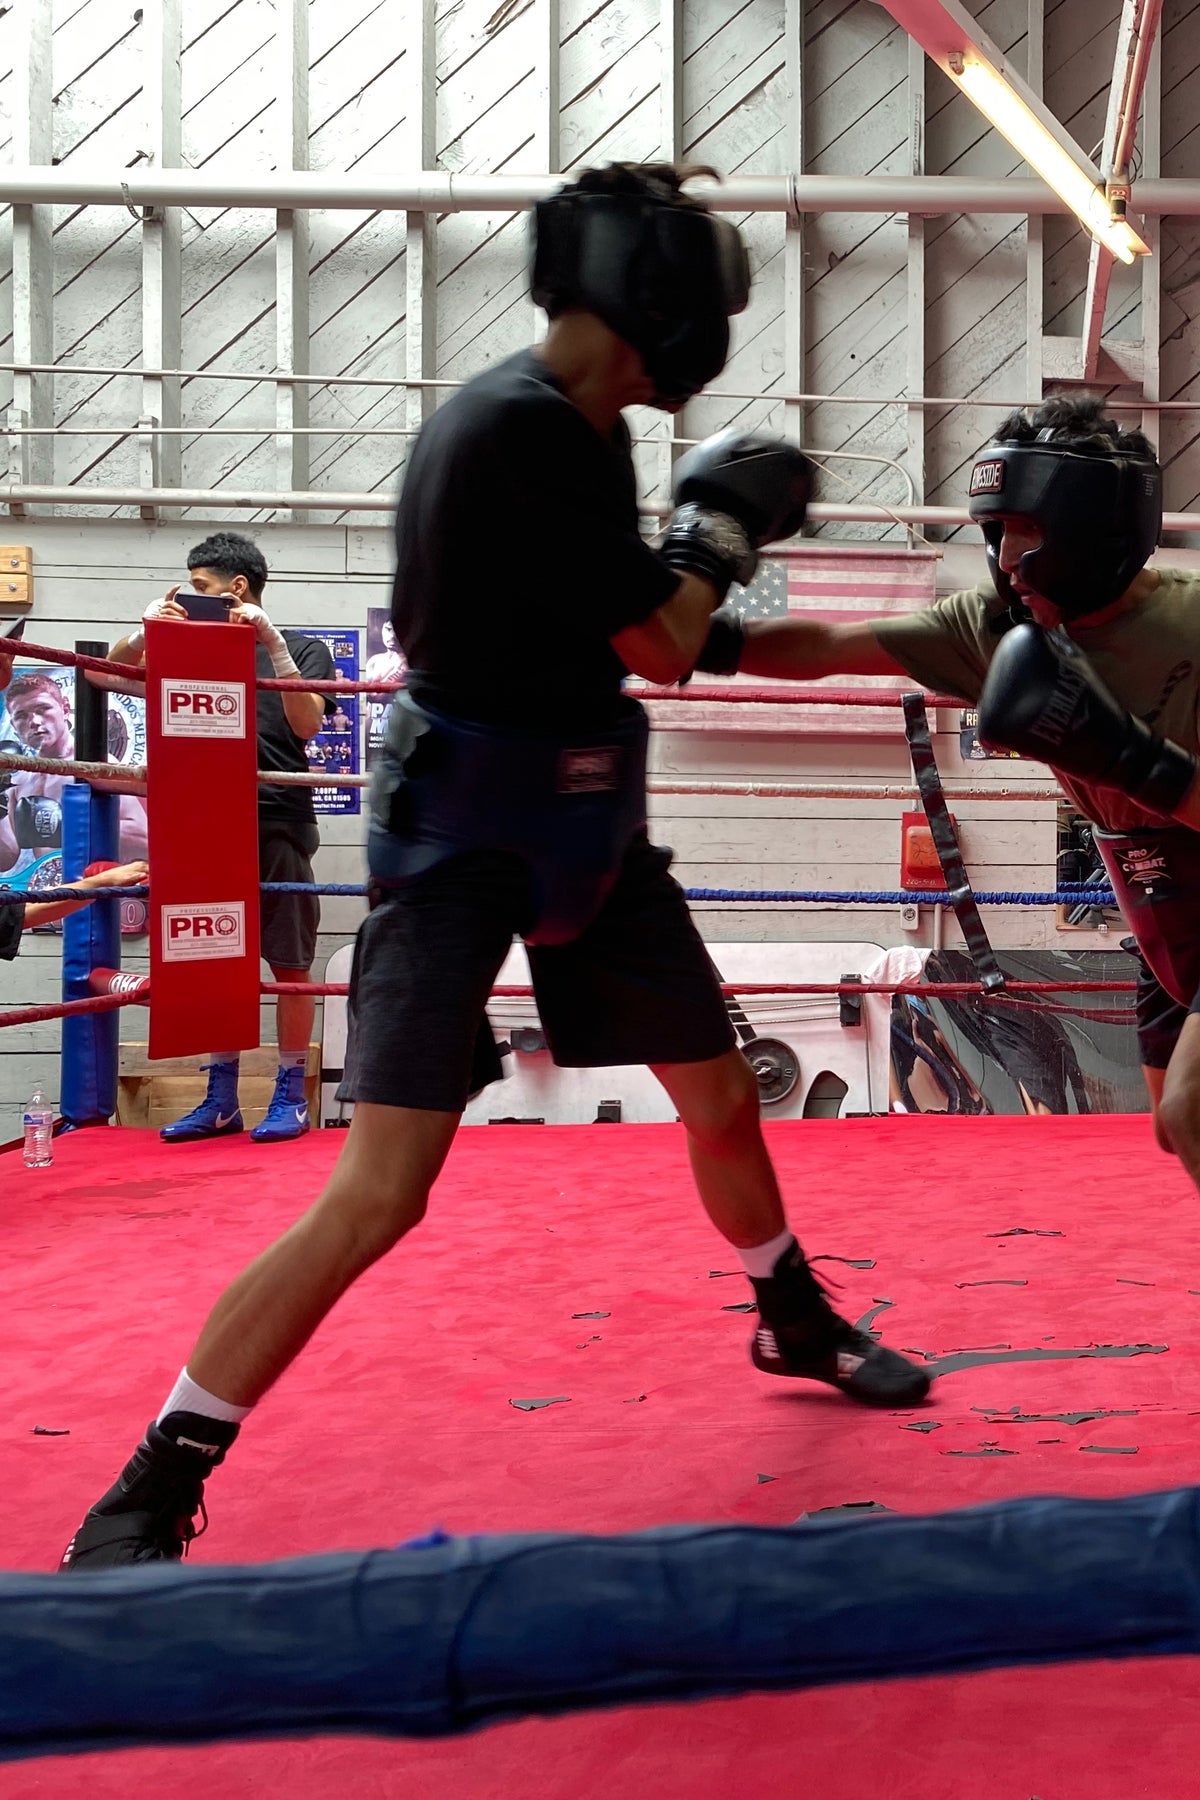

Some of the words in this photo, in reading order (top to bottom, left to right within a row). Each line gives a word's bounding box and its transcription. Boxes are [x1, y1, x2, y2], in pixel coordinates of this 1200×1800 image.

[170, 692, 238, 716] PRO
[1127, 848, 1148, 859] PRO
[170, 914, 237, 939] PRO
